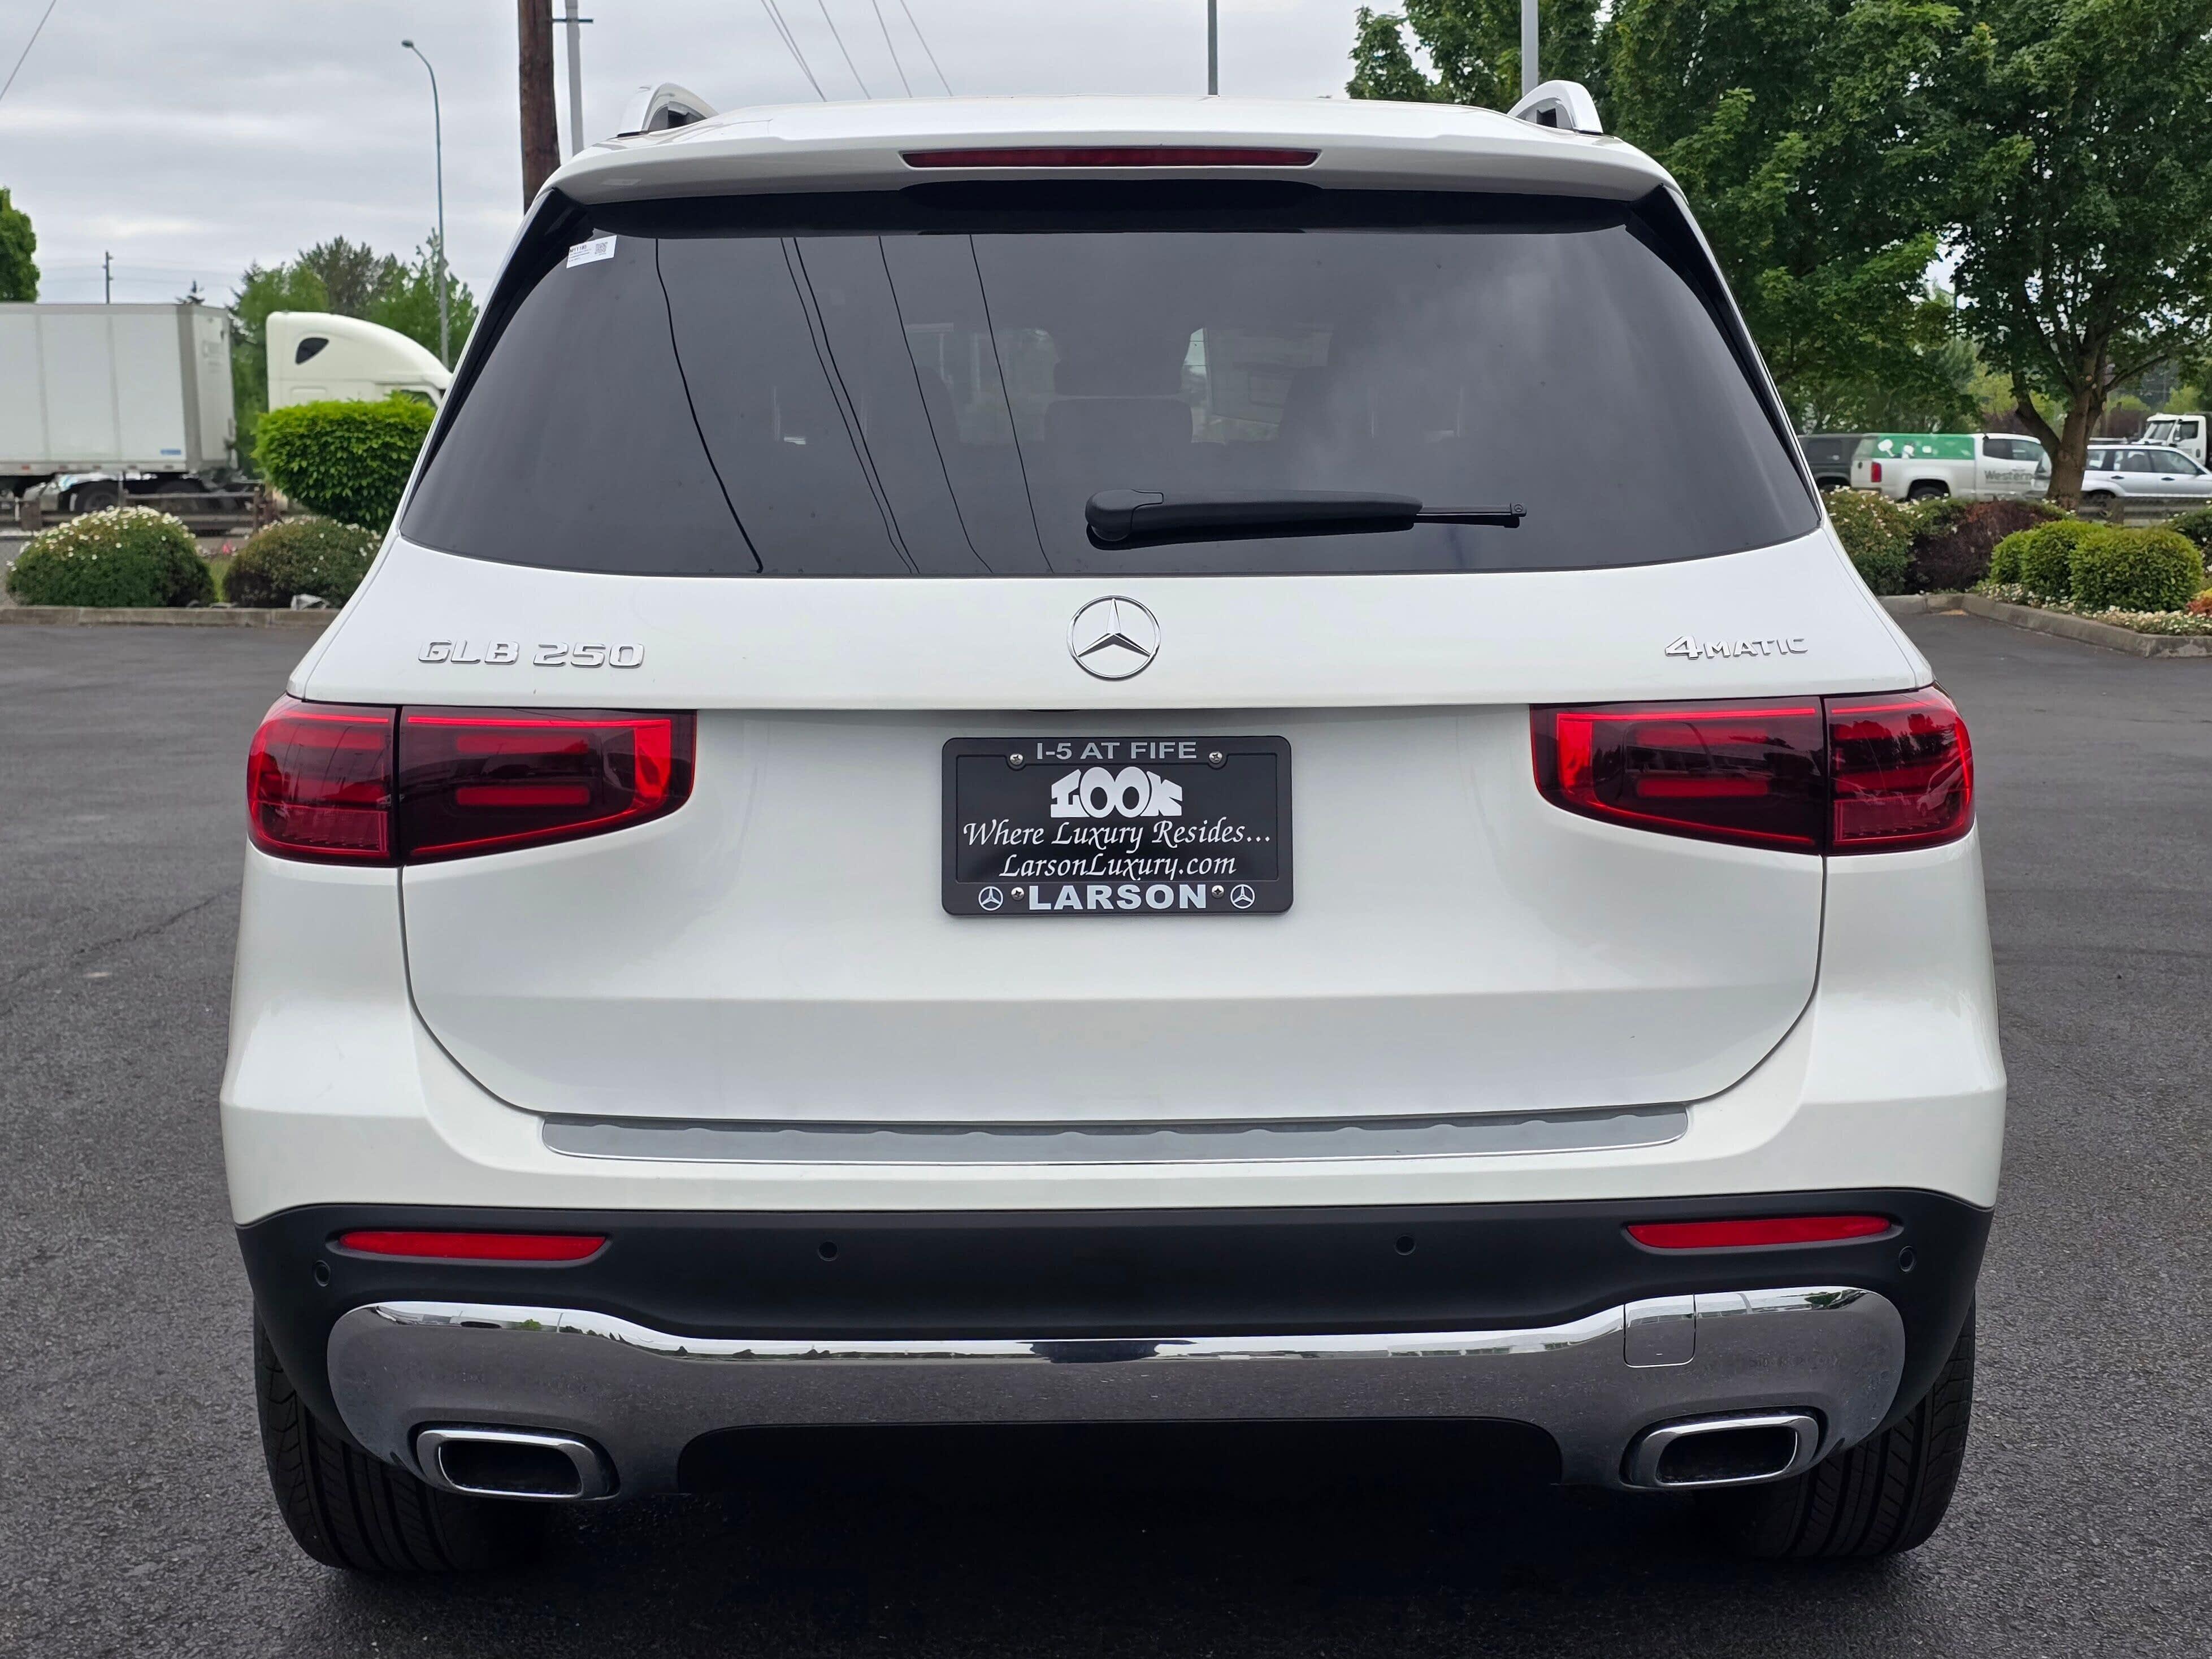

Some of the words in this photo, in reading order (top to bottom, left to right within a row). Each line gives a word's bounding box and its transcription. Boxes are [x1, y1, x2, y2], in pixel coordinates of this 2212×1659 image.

[418, 639, 520, 665] GLB
[533, 641, 645, 668] 250
[1665, 635, 1808, 660] 4MATIC
[1037, 742, 1072, 759] I-5
[1080, 742, 1120, 759] AT
[1131, 742, 1197, 759] FIFE
[964, 819, 1044, 845] Where
[1051, 822, 1144, 854] Luxury
[1152, 817, 1270, 848] Resides...
[999, 853, 1237, 881] LarsonLuxury.com
[1029, 884, 1206, 910] LARSON
